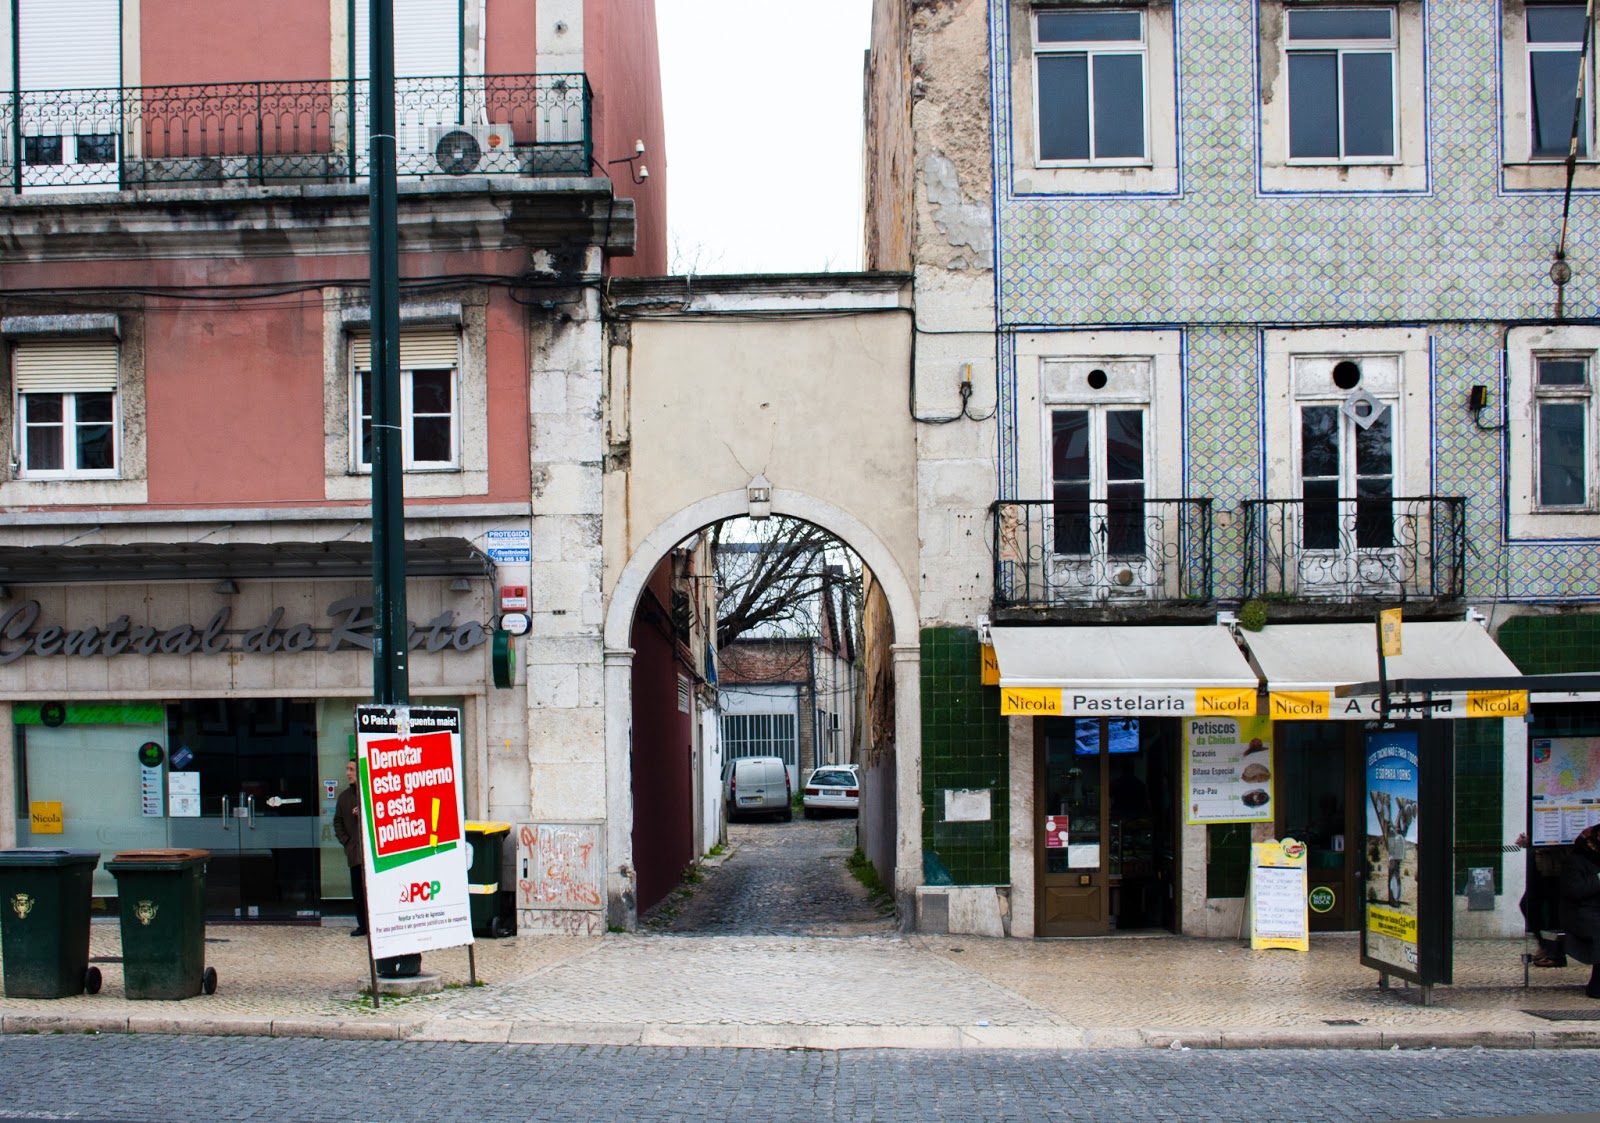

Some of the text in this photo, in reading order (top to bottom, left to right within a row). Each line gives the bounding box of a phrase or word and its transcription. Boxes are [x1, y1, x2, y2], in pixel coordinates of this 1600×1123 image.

[0, 600, 231, 665] Central
[241, 606, 317, 655] do
[1008, 696, 1055, 710] Nicola
[1072, 695, 1185, 710] Pastelaria
[1202, 695, 1249, 711] Nicola
[1276, 699, 1323, 715] Nicola
[1345, 700, 1362, 713] A
[1472, 696, 1520, 713] Nicola
[362, 714, 369, 725] O
[370, 714, 388, 726] País
[409, 716, 436, 728] guenta
[436, 716, 456, 726] mais!
[1192, 722, 1236, 734] Petiscos
[1196, 736, 1236, 745] da Chilena
[370, 745, 422, 770] Derrotar
[1192, 768, 1234, 776] Bifana Especial
[373, 767, 453, 795] este governo
[376, 794, 416, 819] e esta
[32, 814, 60, 822] Nicola
[378, 816, 426, 848] política
[410, 880, 441, 902] PCP
